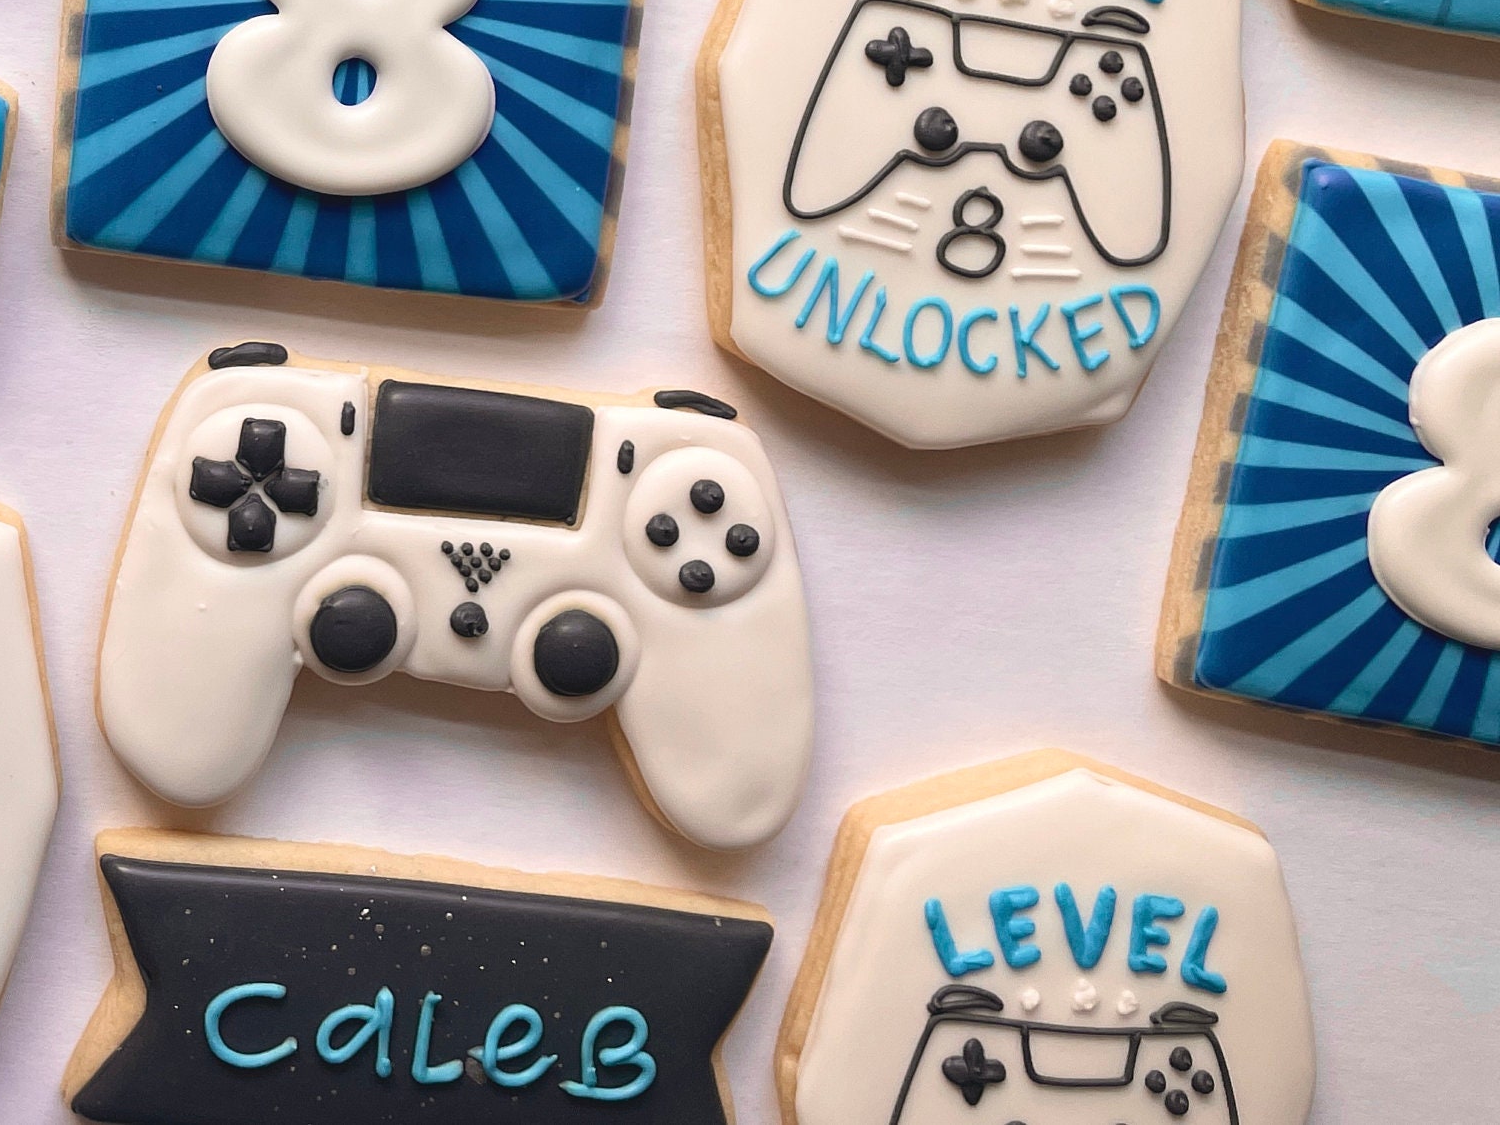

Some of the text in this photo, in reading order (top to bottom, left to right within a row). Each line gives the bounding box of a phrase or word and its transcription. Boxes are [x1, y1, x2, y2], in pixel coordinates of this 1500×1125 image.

[936, 186, 1006, 277] 8
[747, 229, 1161, 378] UNLOCKED
[924, 882, 1227, 993] LEVEL
